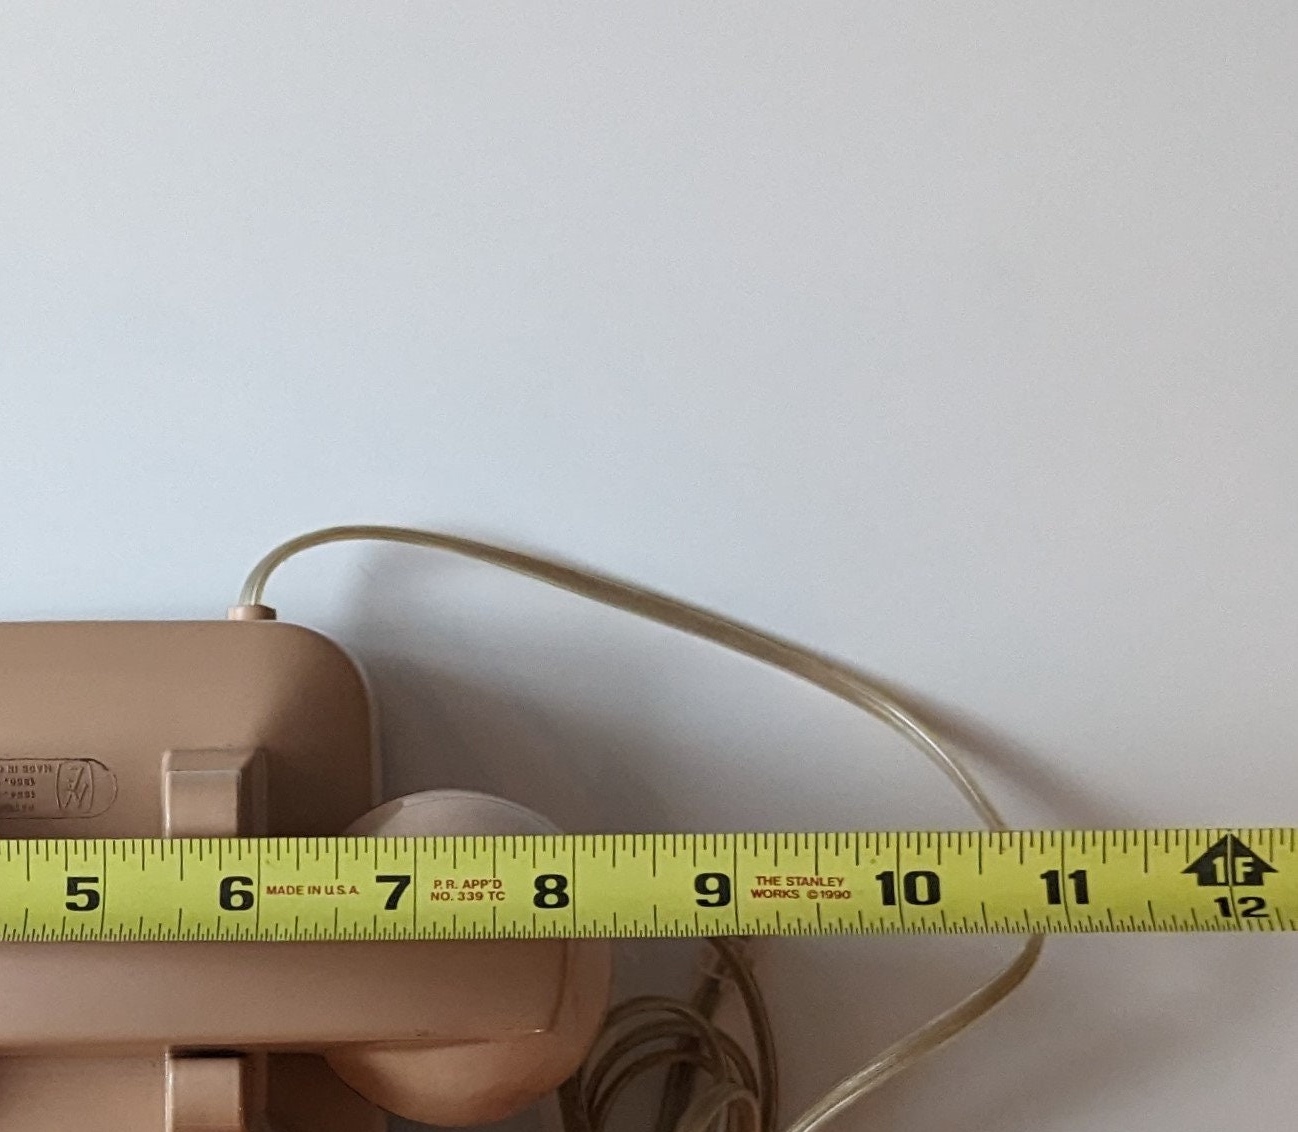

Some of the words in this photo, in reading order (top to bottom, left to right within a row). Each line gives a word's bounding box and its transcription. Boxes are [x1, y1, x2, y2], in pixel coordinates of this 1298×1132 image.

[462, 879, 502, 890] APP'D
[755, 876, 782, 887] THE
[786, 876, 845, 887] STANLEY
[1212, 856, 1254, 884] 1F
[65, 876, 101, 912] 5
[218, 876, 254, 912] 6
[266, 885, 305, 896] MADE
[307, 885, 324, 896] IN
[376, 874, 412, 910] 7
[430, 891, 454, 901] NO.
[457, 891, 484, 901] 339
[488, 891, 506, 901] TC
[532, 874, 570, 910] 8
[694, 872, 732, 908] 9
[751, 888, 800, 900] WORKS
[875, 870, 942, 906] 10
[1040, 869, 1090, 906] 11
[1214, 896, 1270, 918] 12
